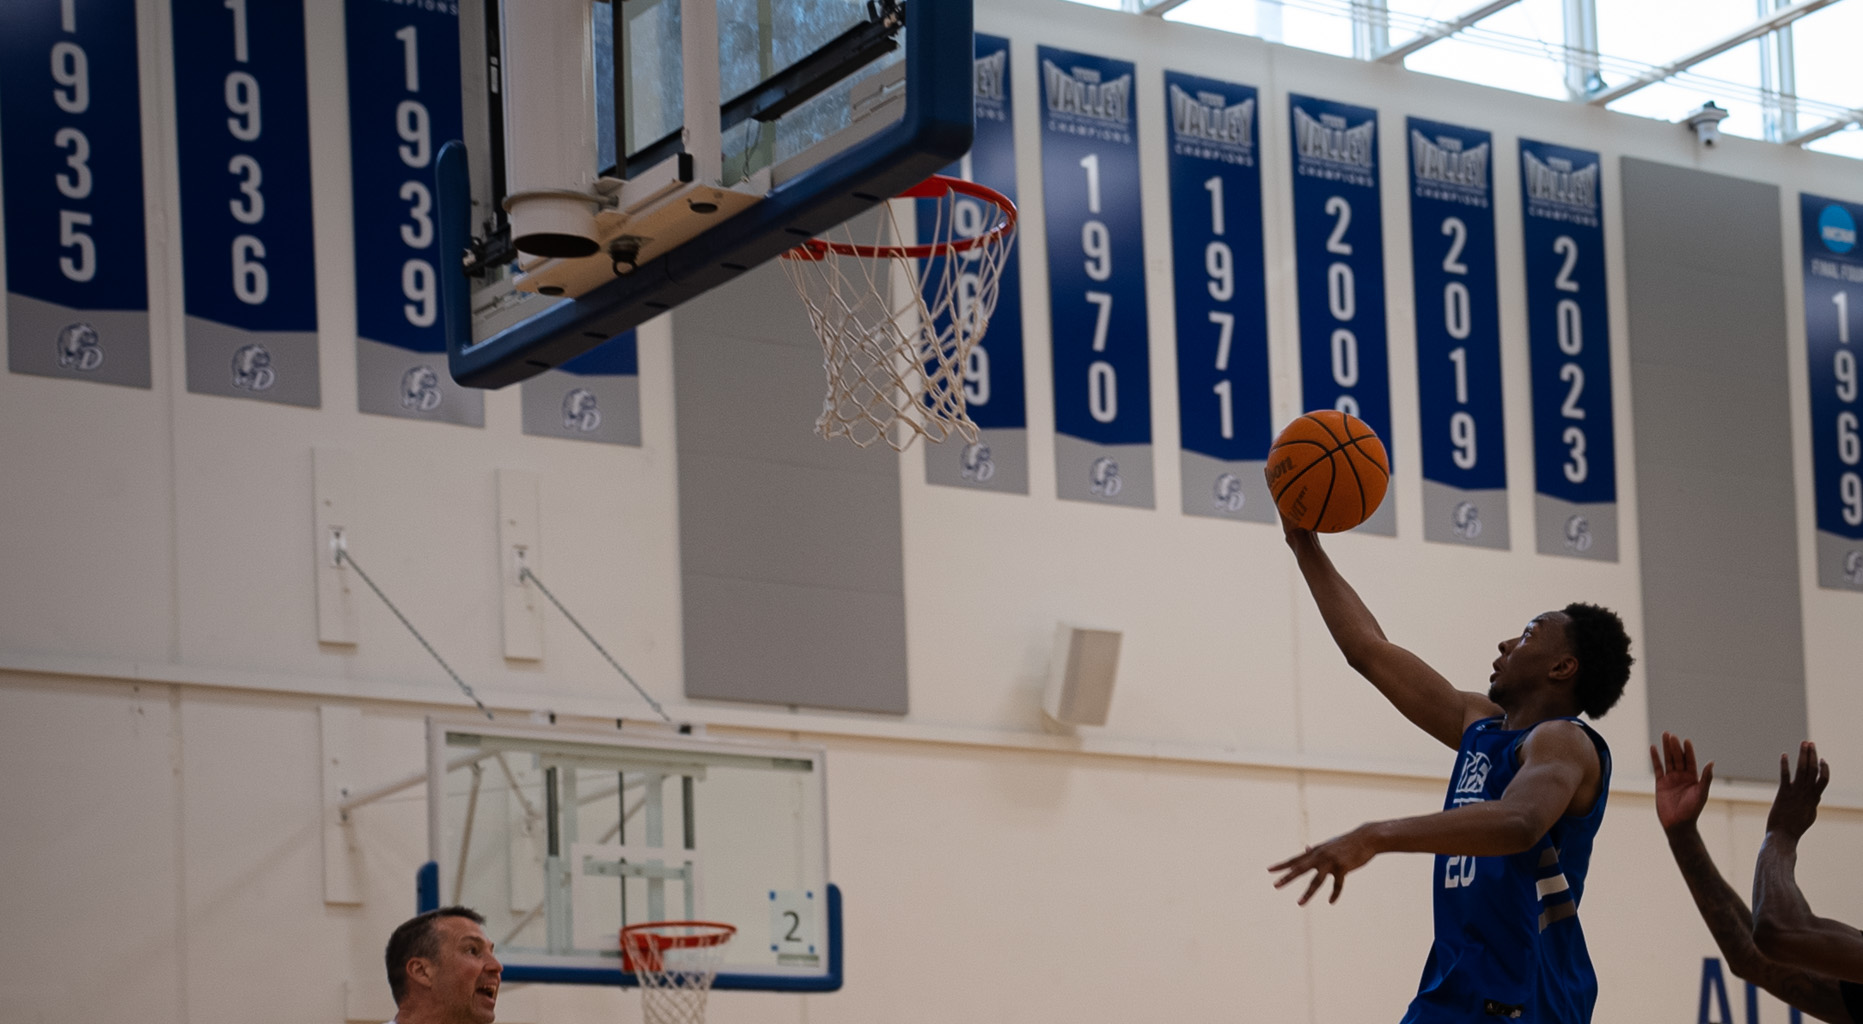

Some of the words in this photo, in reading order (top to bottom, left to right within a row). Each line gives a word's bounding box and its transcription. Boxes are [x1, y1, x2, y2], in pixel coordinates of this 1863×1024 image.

[1043, 58, 1131, 125] VALLEY
[1169, 83, 1255, 148] VALLEY
[224, 0, 269, 306] 1936
[1293, 106, 1375, 168] VALLEY
[1411, 128, 1490, 189] VALLEY
[395, 25, 438, 329] 1939
[1522, 149, 1598, 209] VALLEY
[1080, 153, 1118, 424] 1970
[1841, 263, 1863, 284] FOU
[1204, 175, 1236, 440] 1971
[1440, 217, 1477, 470] 2019
[1553, 236, 1588, 484] 2023
[1832, 291, 1862, 526] 1969
[1445, 855, 1476, 888] 20
[783, 910, 802, 942] 2
